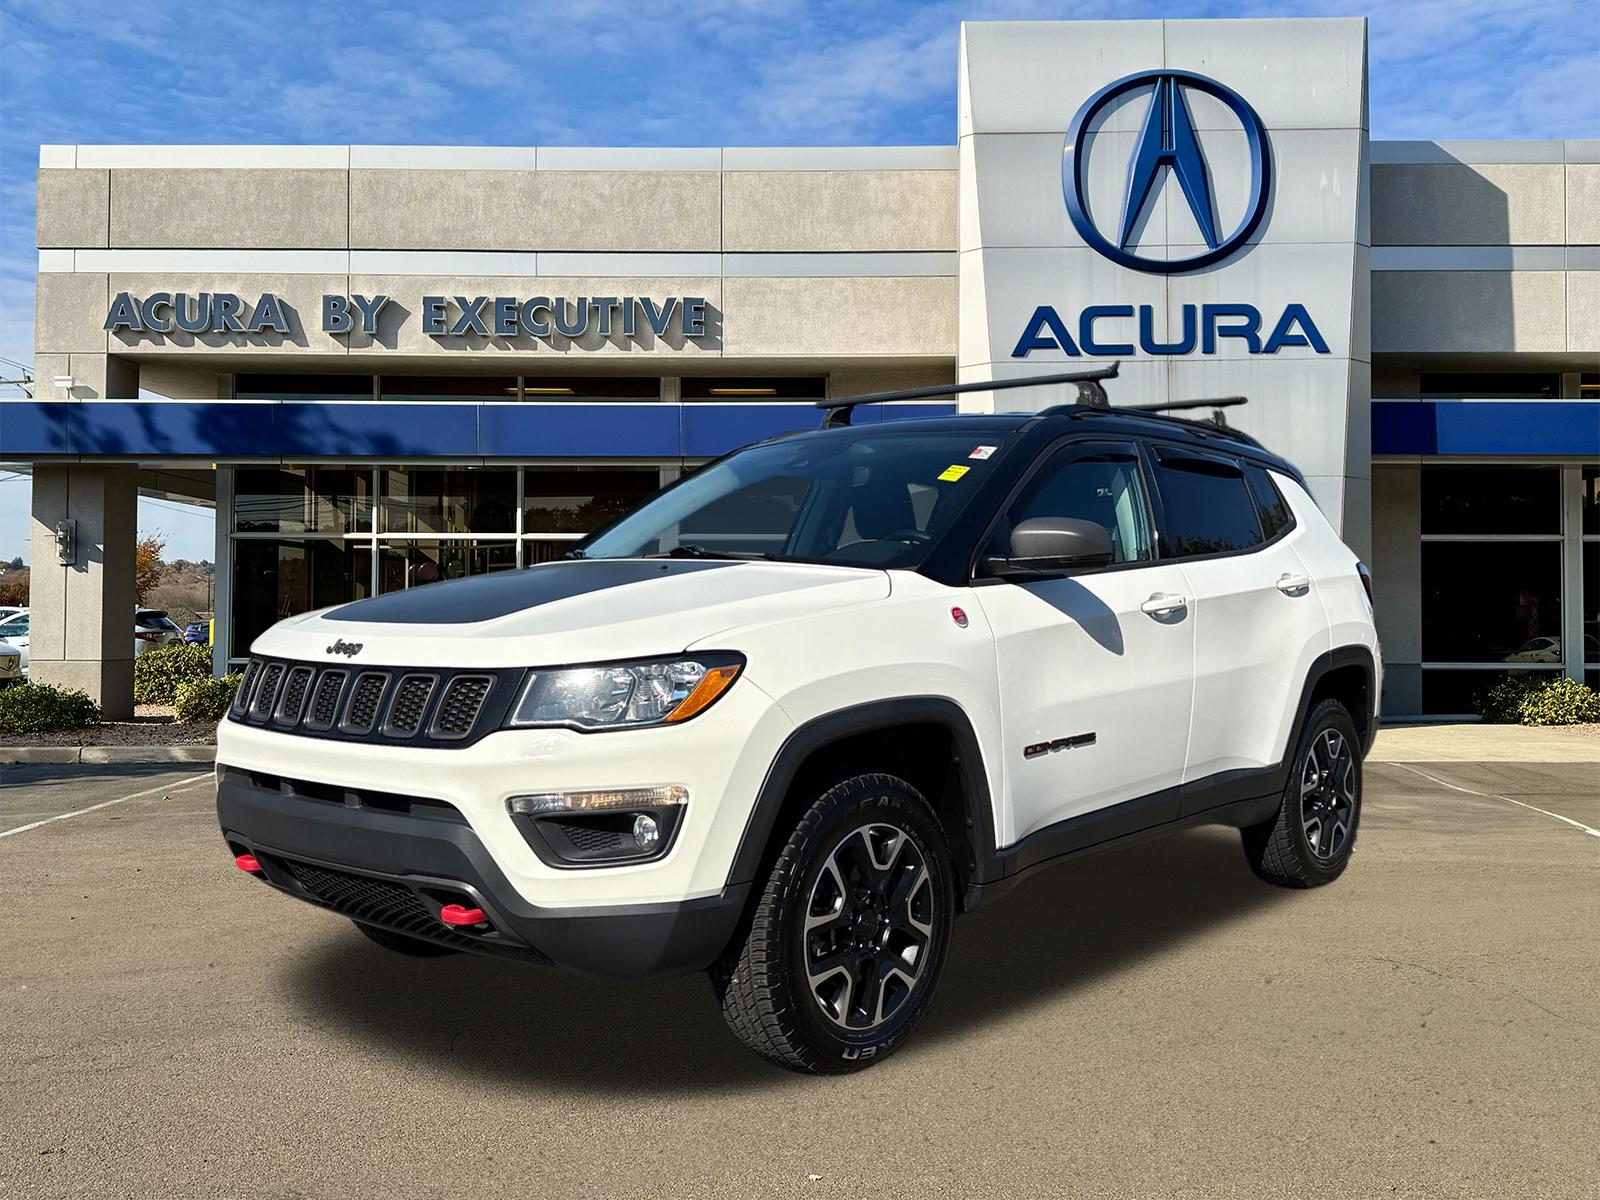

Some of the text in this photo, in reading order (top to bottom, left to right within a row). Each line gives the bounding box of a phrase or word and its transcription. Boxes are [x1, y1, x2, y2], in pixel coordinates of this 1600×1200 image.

[103, 292, 706, 337] ACURA BY EXECUTIVE
[1010, 303, 1332, 357] ACURA
[326, 638, 363, 658] Jeep
